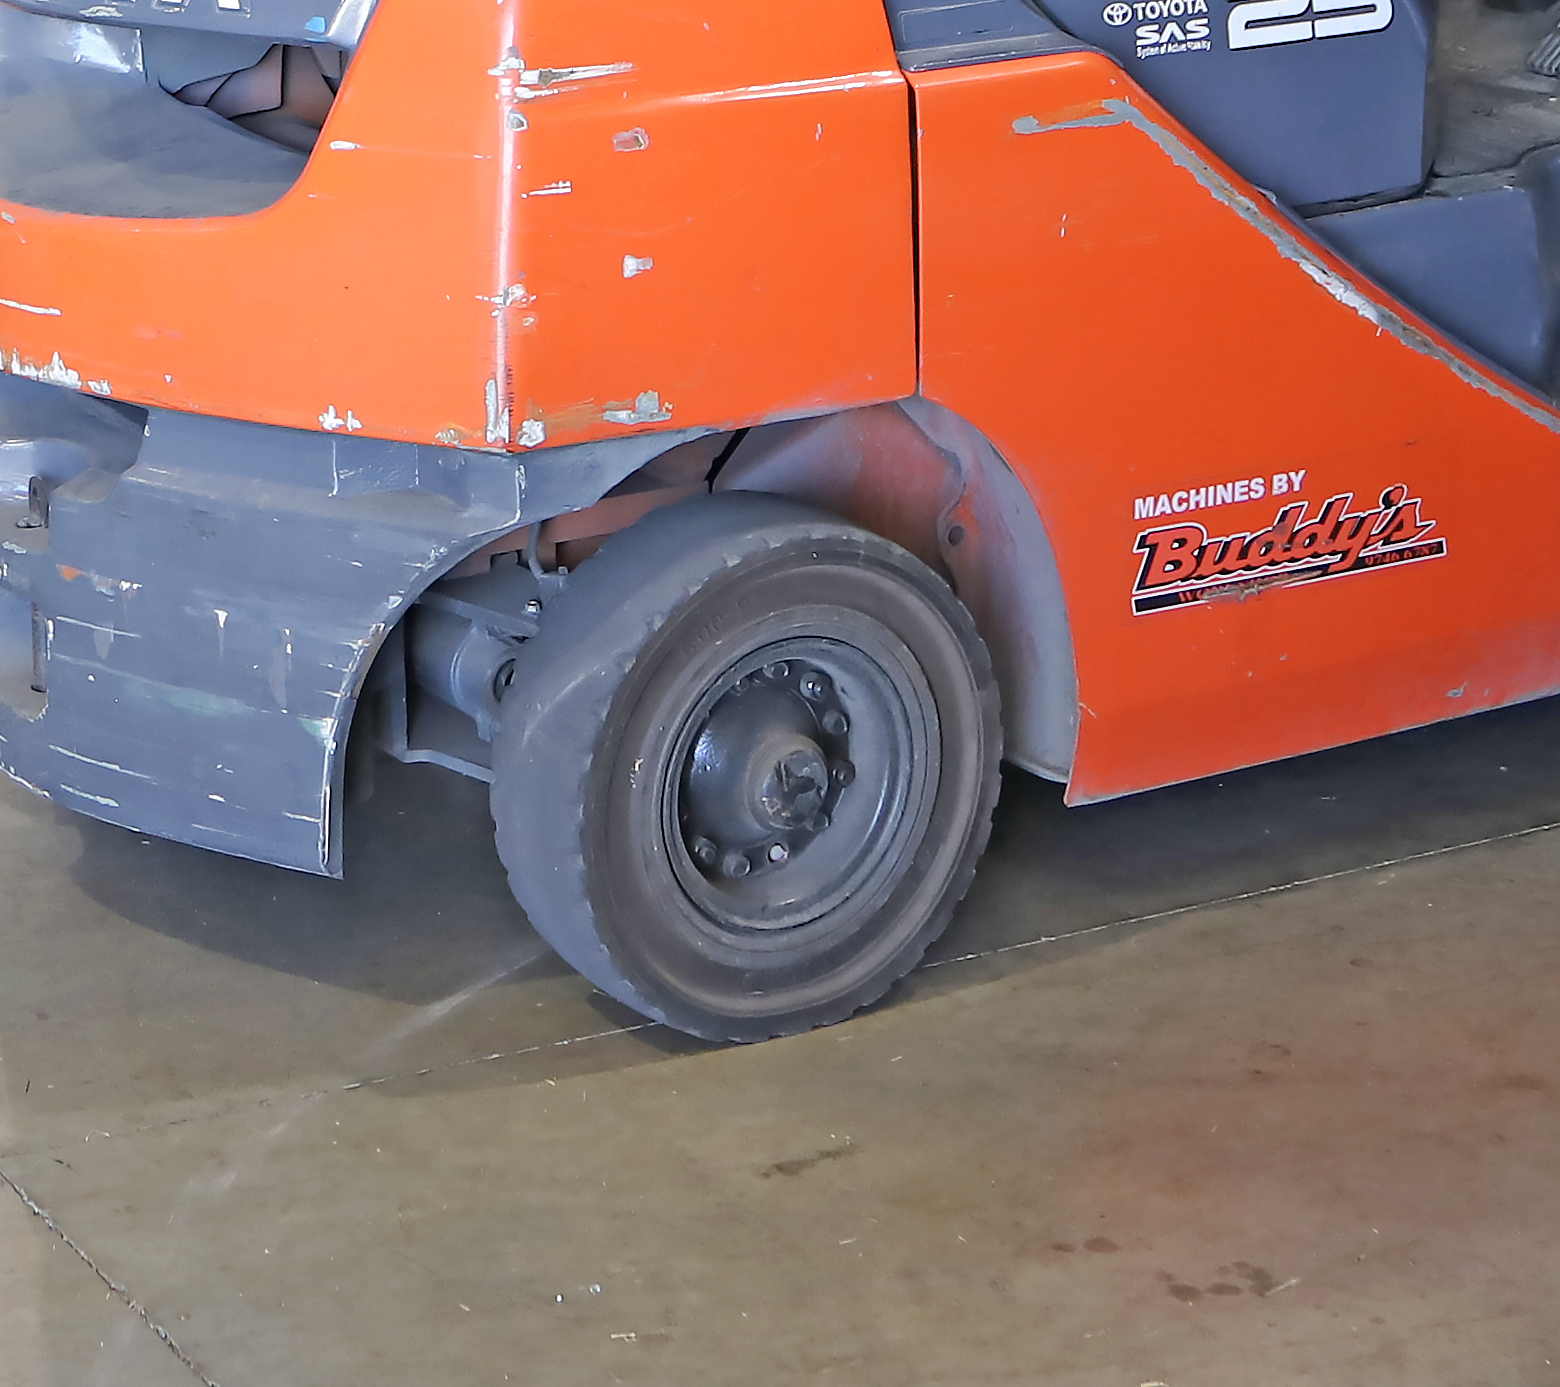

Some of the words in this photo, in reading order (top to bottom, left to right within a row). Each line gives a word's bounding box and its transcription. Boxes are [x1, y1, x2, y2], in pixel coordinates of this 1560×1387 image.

[1136, 17, 1211, 47] SAS
[1132, 477, 1267, 520] MACHINES
[1272, 469, 1308, 496] BY
[1133, 483, 1437, 595] Buddy's
